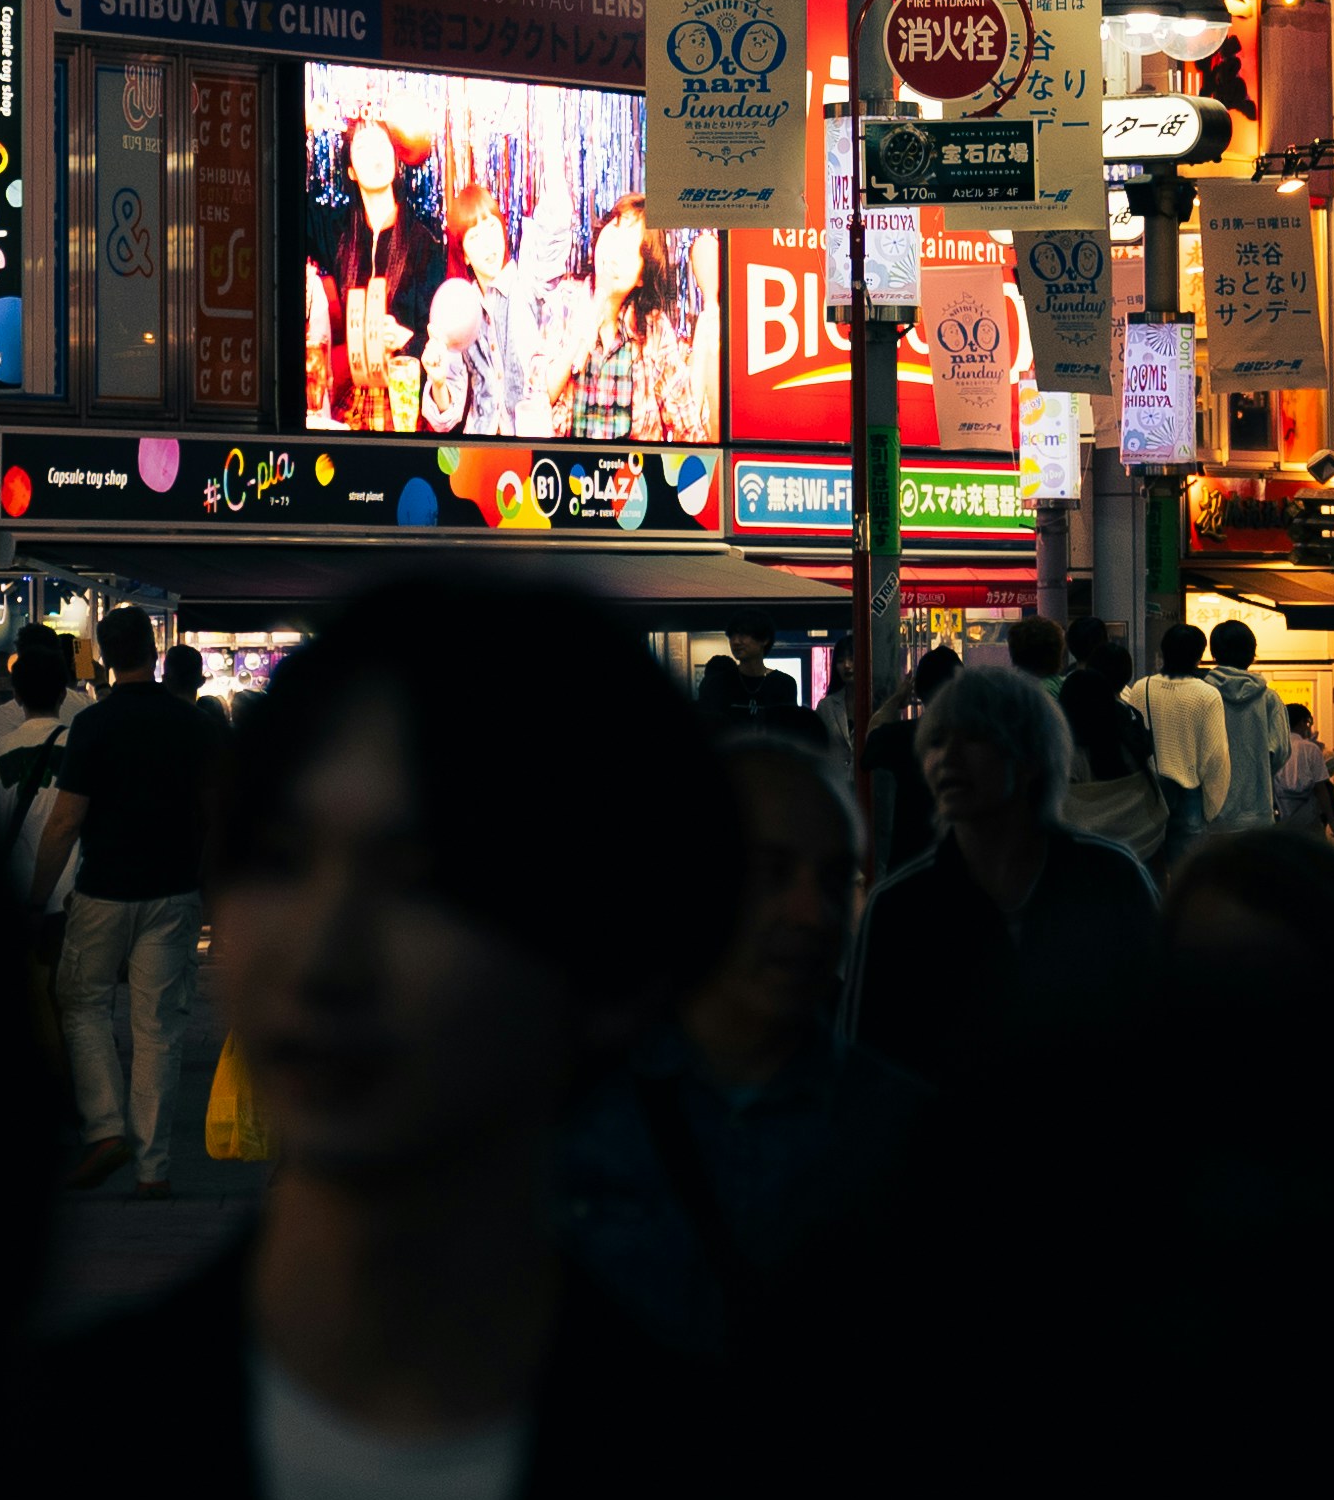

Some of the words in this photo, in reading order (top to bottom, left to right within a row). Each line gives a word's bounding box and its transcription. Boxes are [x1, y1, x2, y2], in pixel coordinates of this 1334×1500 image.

[694, 0, 760, 19] SHIBUYA
[0, 6, 14, 57] Capsule
[279, 4, 368, 41] CLINIC
[391, 9, 645, 70] 渋谷コンタクトレンズ
[897, 15, 999, 63] 消火栓
[0, 60, 13, 82] toy
[682, 74, 771, 94] nari
[0, 84, 13, 117] shop
[663, 94, 789, 128] Sunday
[941, 142, 1030, 165] 宝石広場
[199, 166, 252, 187] SHIBUYA
[677, 187, 776, 202] 渋谷センター街
[902, 187, 937, 201] 170m
[199, 204, 231, 223] LENS
[1209, 216, 1302, 231] 6月第一日曜日は
[1235, 241, 1284, 267] 渋谷
[1043, 279, 1099, 295] nari
[1214, 271, 1308, 297] おとなり
[1034, 294, 1107, 319] Sunday
[1214, 300, 1312, 327] サンデー
[949, 349, 995, 365] nari
[941, 364, 1005, 387] Sunday
[598, 458, 625, 471] Capsule
[48, 466, 84, 488] Capsule
[85, 470, 103, 490] toy
[104, 470, 128, 491] shop
[203, 447, 296, 514] #C-pla
[536, 475, 555, 500] B1
[766, 475, 852, 513] 無料Wi-Fi
